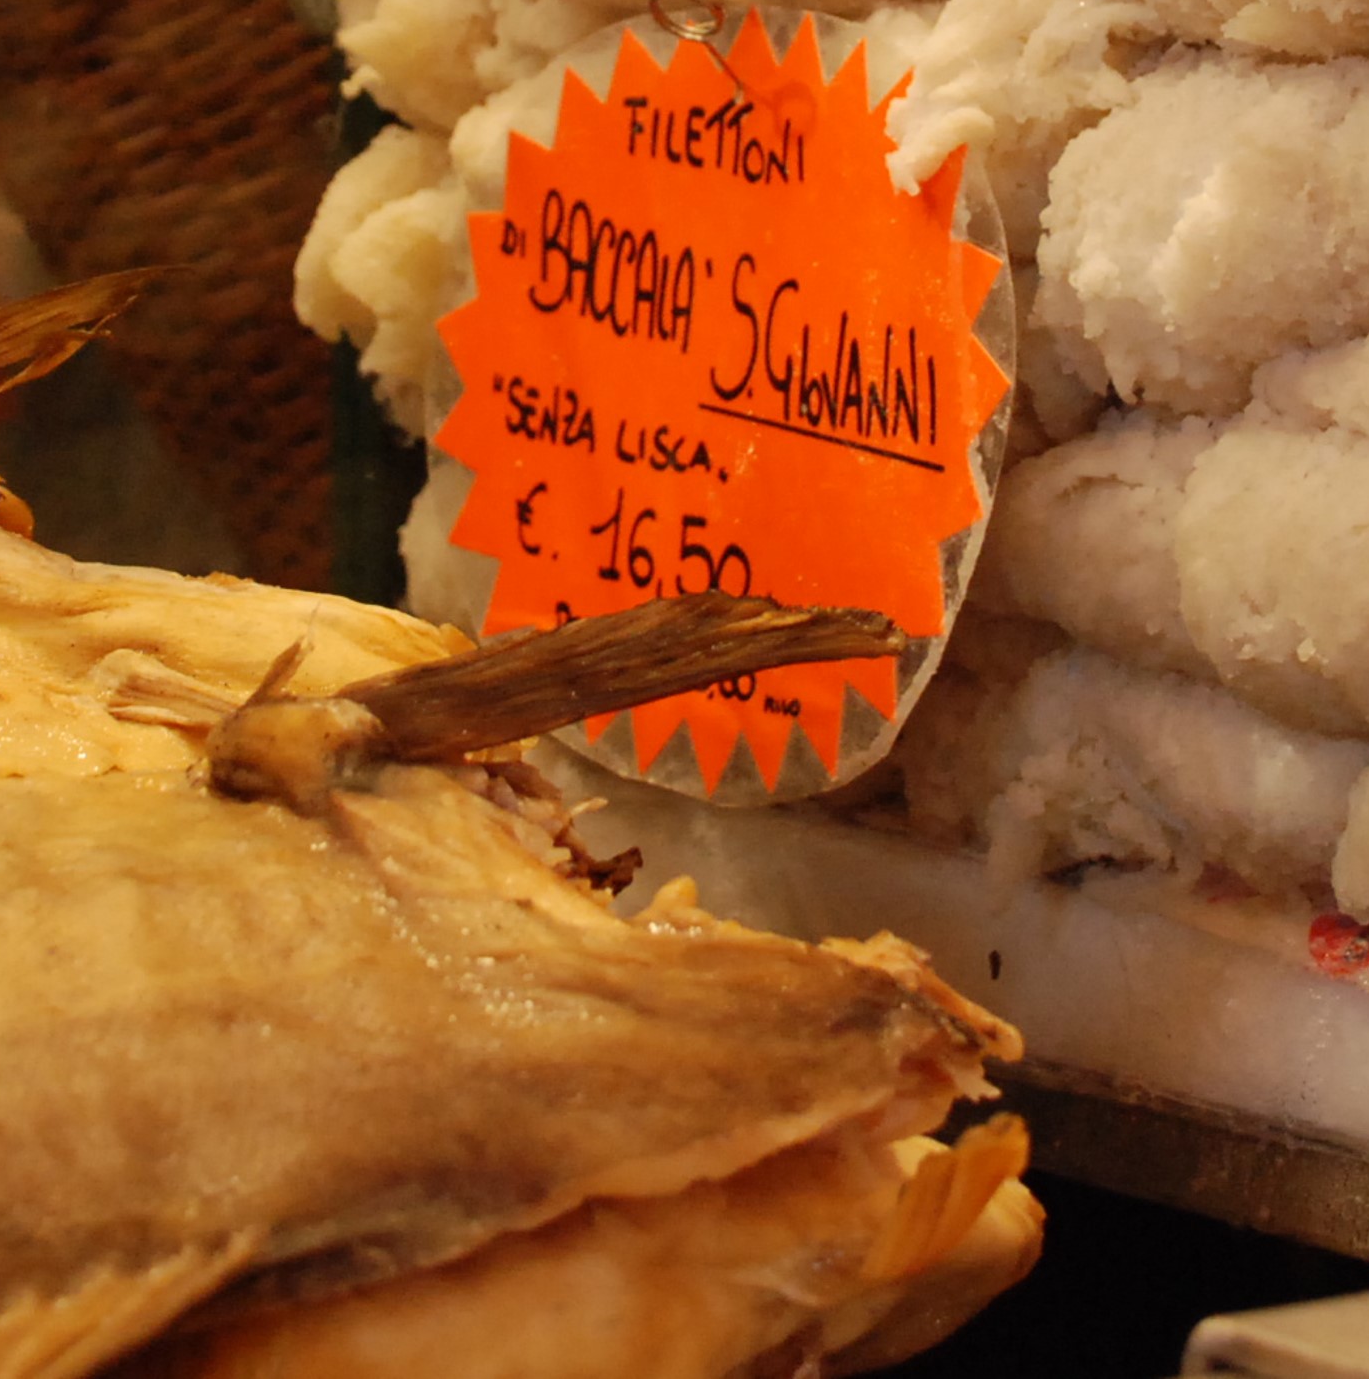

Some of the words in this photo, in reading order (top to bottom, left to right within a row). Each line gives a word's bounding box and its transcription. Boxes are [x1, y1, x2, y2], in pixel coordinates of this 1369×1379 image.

[624, 96, 805, 184] FILETTONI
[500, 219, 527, 259] DI
[589, 487, 752, 599] 16,50
